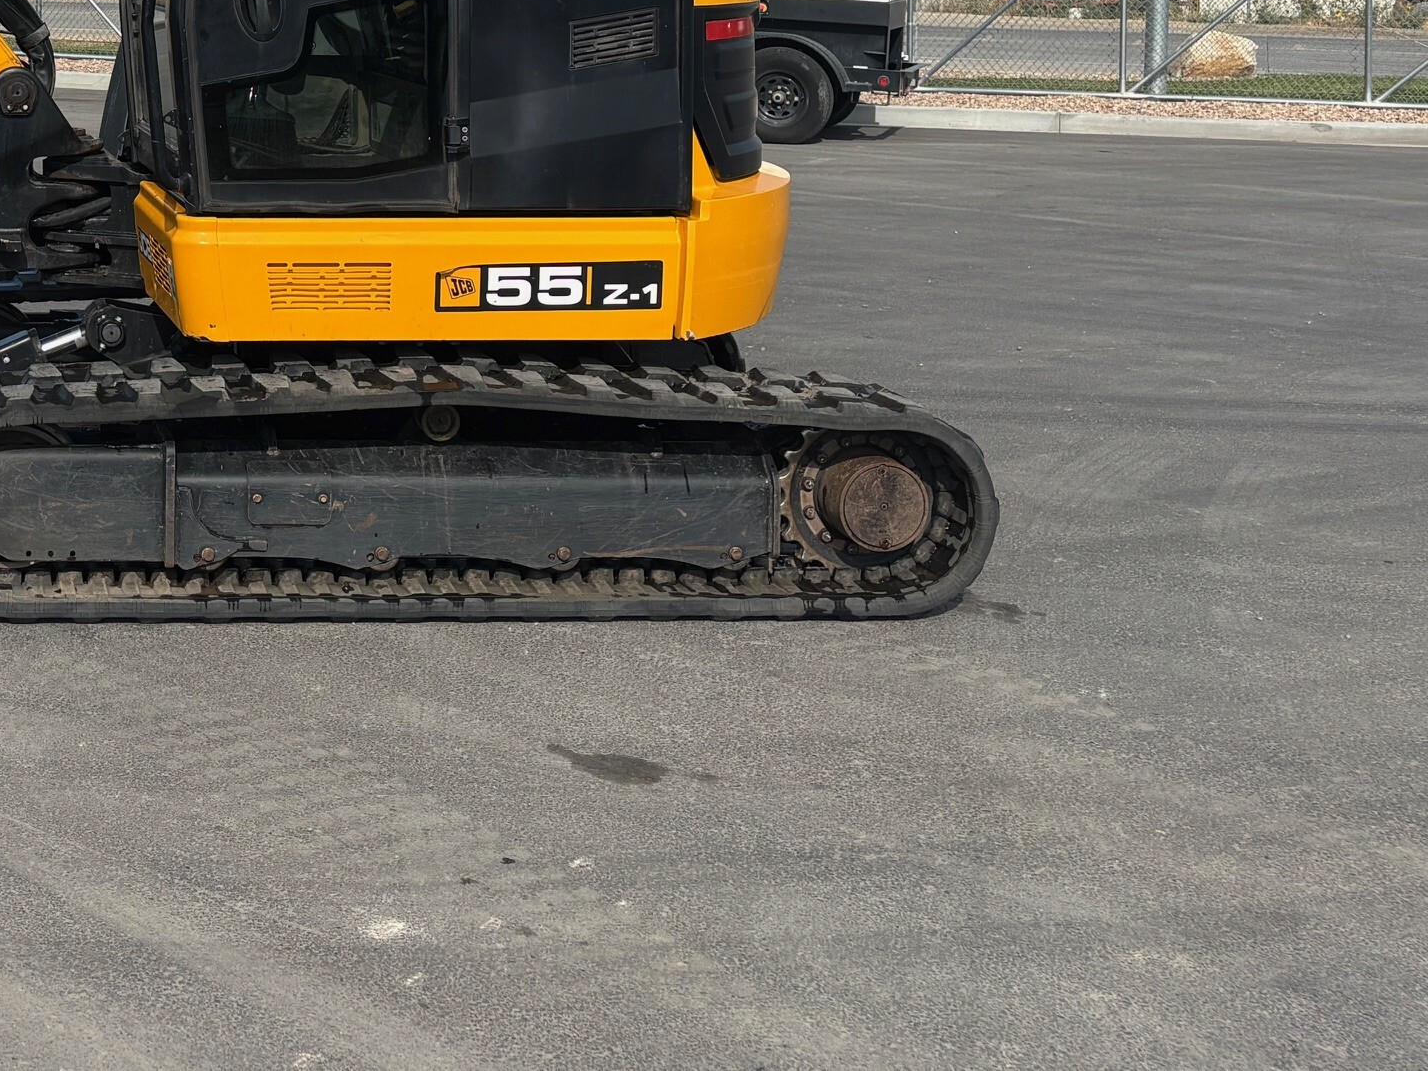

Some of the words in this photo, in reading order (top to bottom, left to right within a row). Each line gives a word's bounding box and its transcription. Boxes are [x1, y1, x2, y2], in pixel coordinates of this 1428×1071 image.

[450, 277, 474, 297] JCB
[486, 266, 583, 307] 55
[603, 283, 658, 305] Z-1
